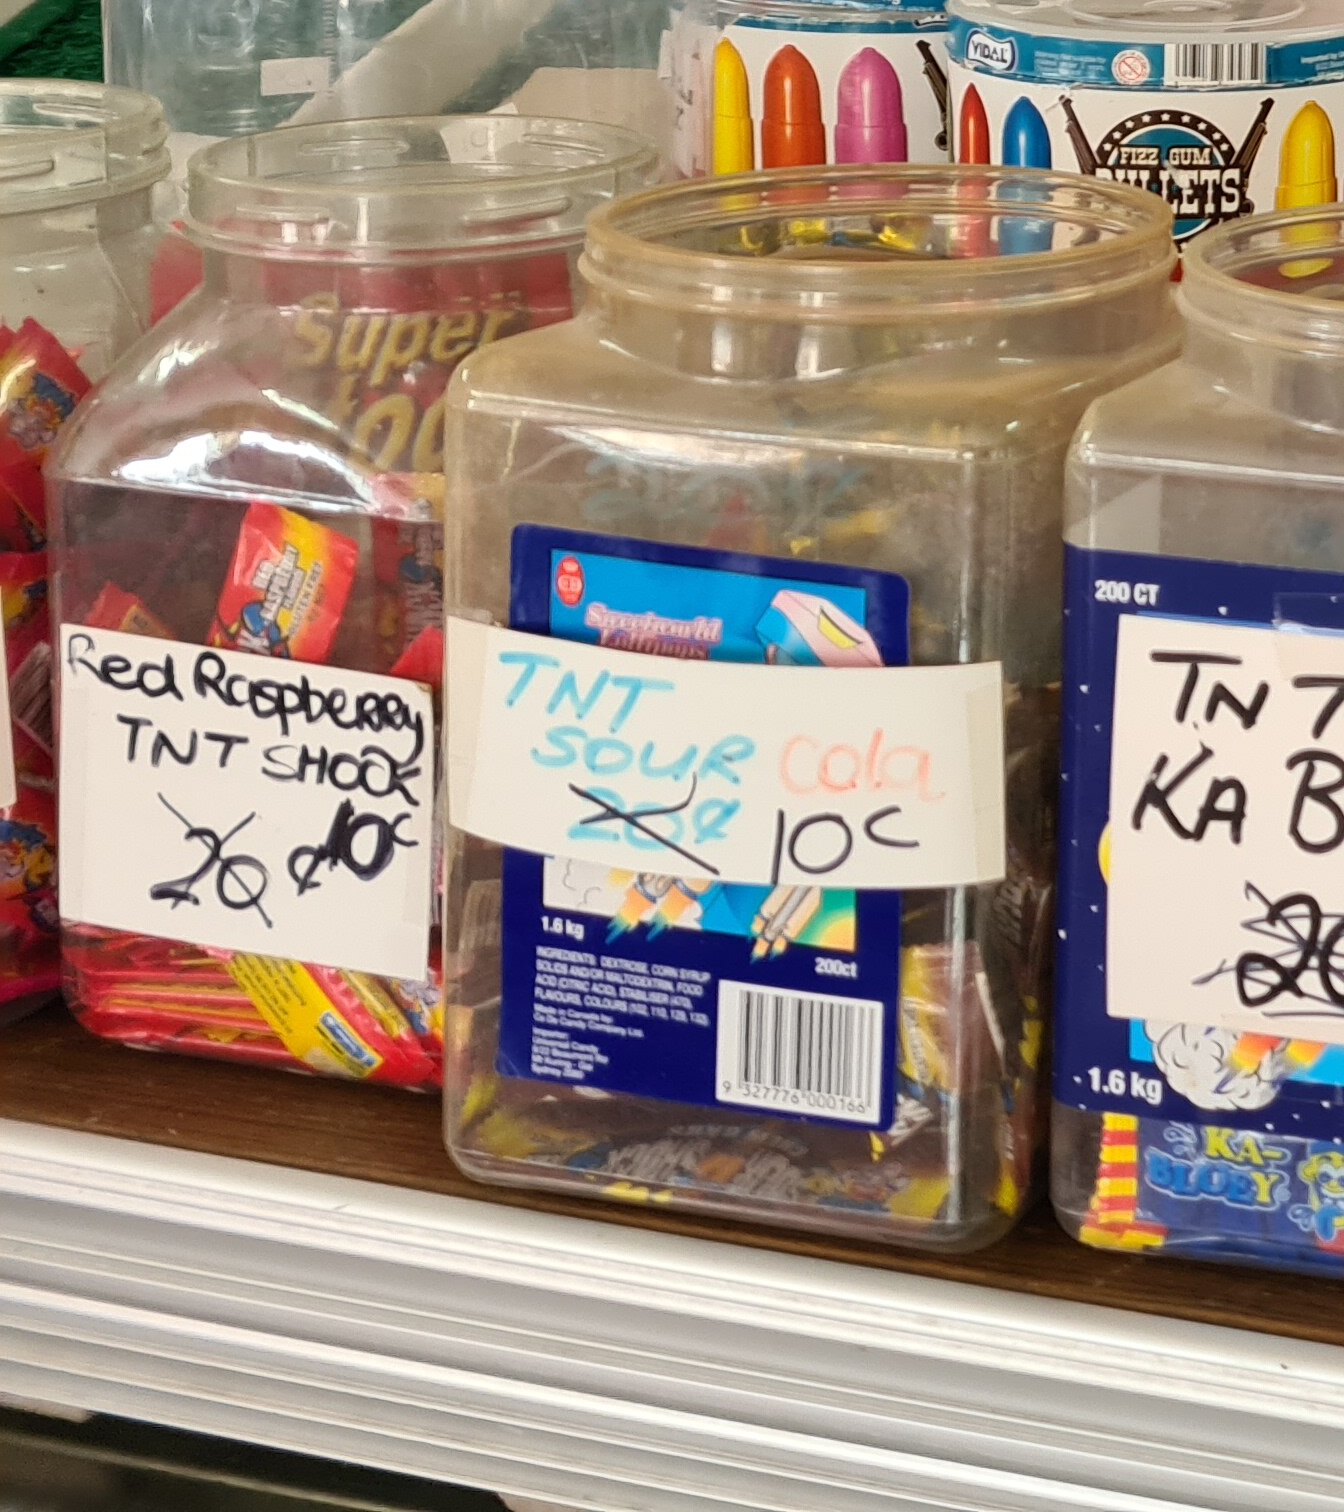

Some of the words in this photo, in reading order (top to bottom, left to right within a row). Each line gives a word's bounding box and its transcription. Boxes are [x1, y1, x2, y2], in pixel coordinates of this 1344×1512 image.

[971, 38, 1009, 63] VIDAL
[1119, 146, 1159, 166] FIZZ
[1168, 146, 1212, 167] GUM
[1094, 579, 1128, 604] 200
[1131, 581, 1160, 608] CT
[66, 632, 183, 700] Red
[497, 649, 676, 734] TNT
[115, 714, 251, 769] TNT
[530, 724, 756, 786] SOUR
[1131, 742, 1248, 844] KA
[540, 914, 564, 935] 1.6
[566, 918, 585, 941] kg
[814, 956, 858, 980] 200ct
[721, 1080, 733, 1096] 9
[1088, 1066, 1126, 1097] 1.6
[1128, 1071, 1164, 1106] kg
